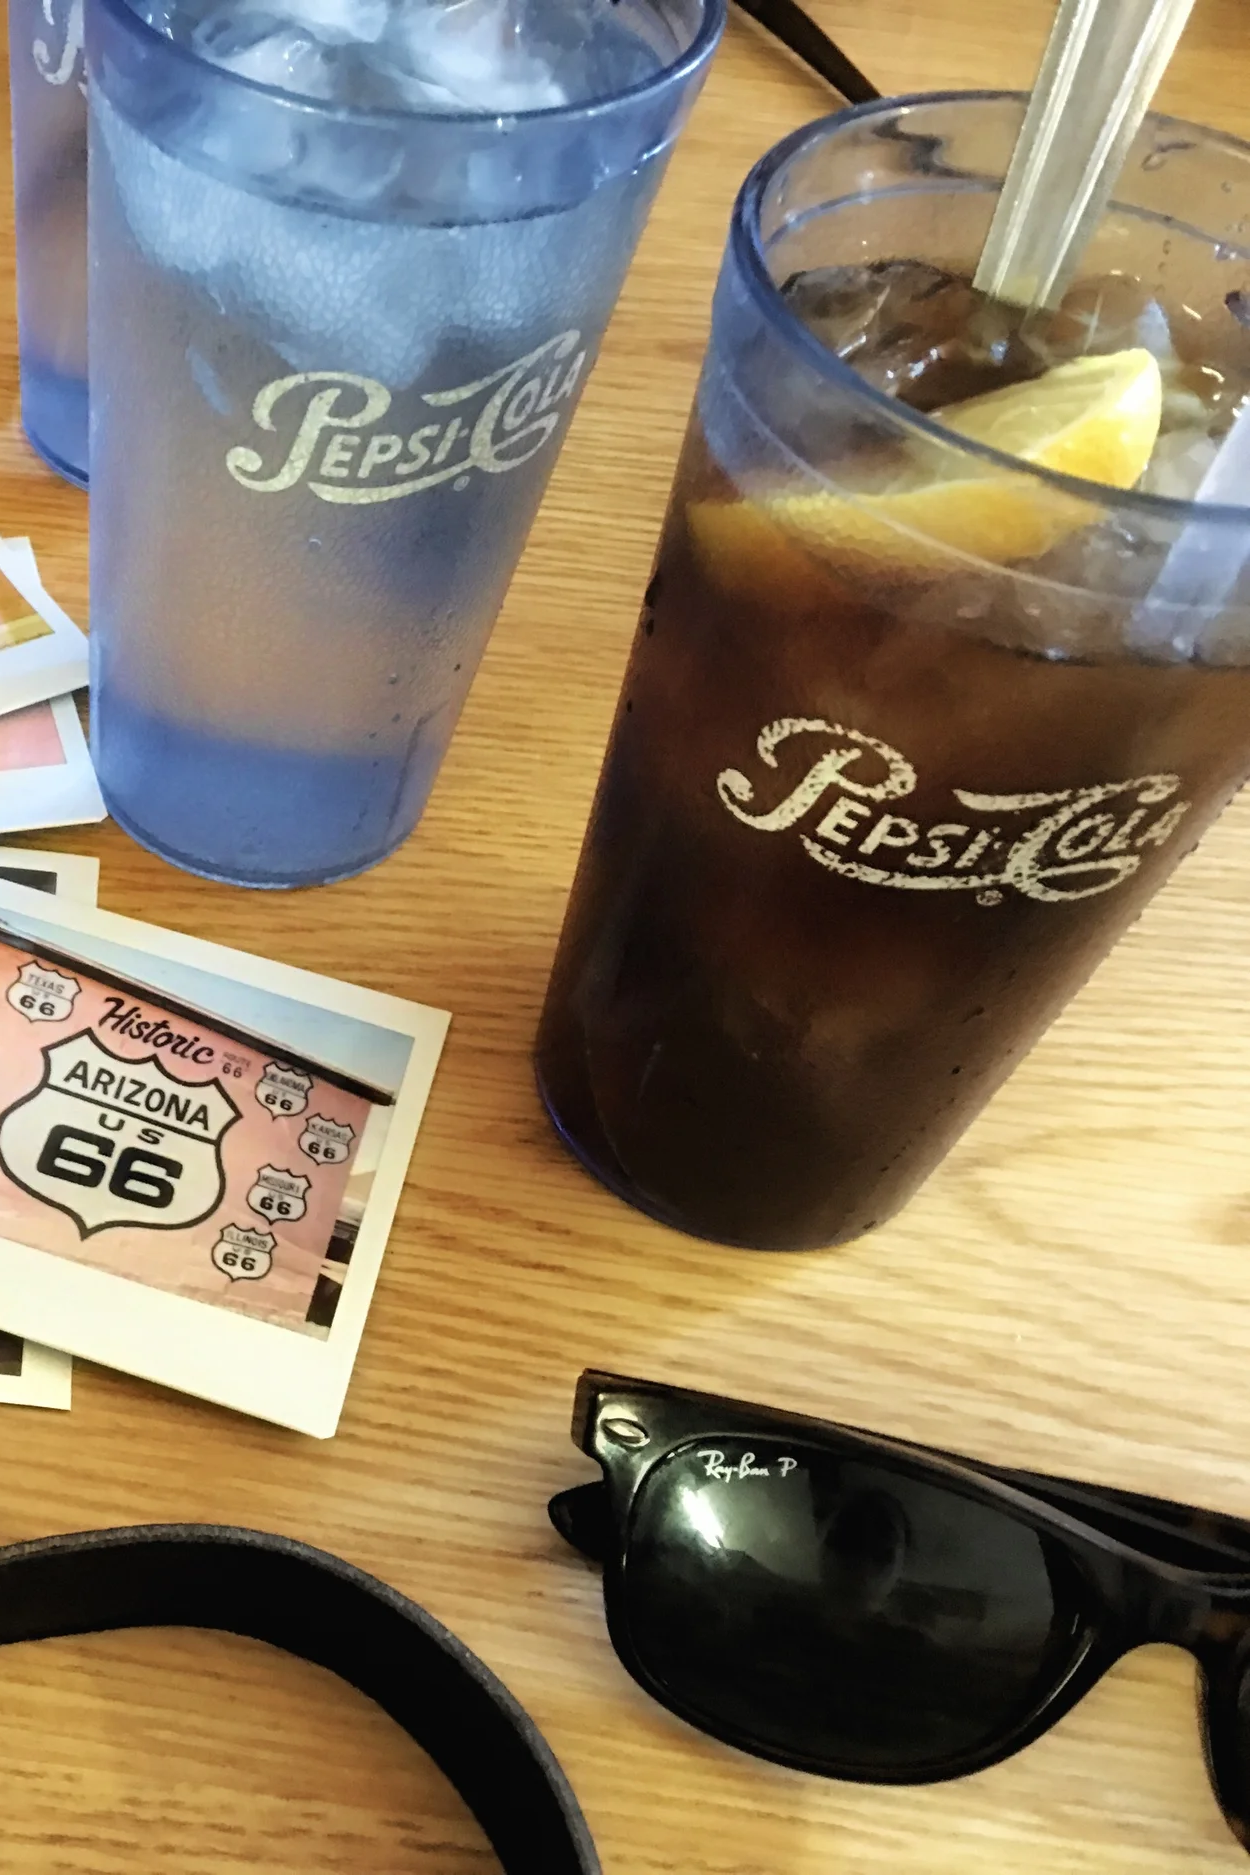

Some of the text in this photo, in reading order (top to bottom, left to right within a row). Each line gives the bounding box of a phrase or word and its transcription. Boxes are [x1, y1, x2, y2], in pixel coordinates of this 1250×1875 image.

[28, 973, 65, 994] TEXAS
[19, 994, 56, 1017] 66
[99, 997, 214, 1065] Historic
[222, 1062, 243, 1079] 66
[63, 1060, 209, 1131] ARIZONA
[264, 1093, 293, 1111] 66
[311, 1123, 348, 1142] KANSAS
[308, 1141, 336, 1160] 66
[36, 1124, 184, 1209] 66
[259, 1196, 292, 1215] 66
[226, 1230, 268, 1250] ILLINOIS
[222, 1251, 257, 1271] 66
[696, 1450, 798, 1483] Ray-Ban P
